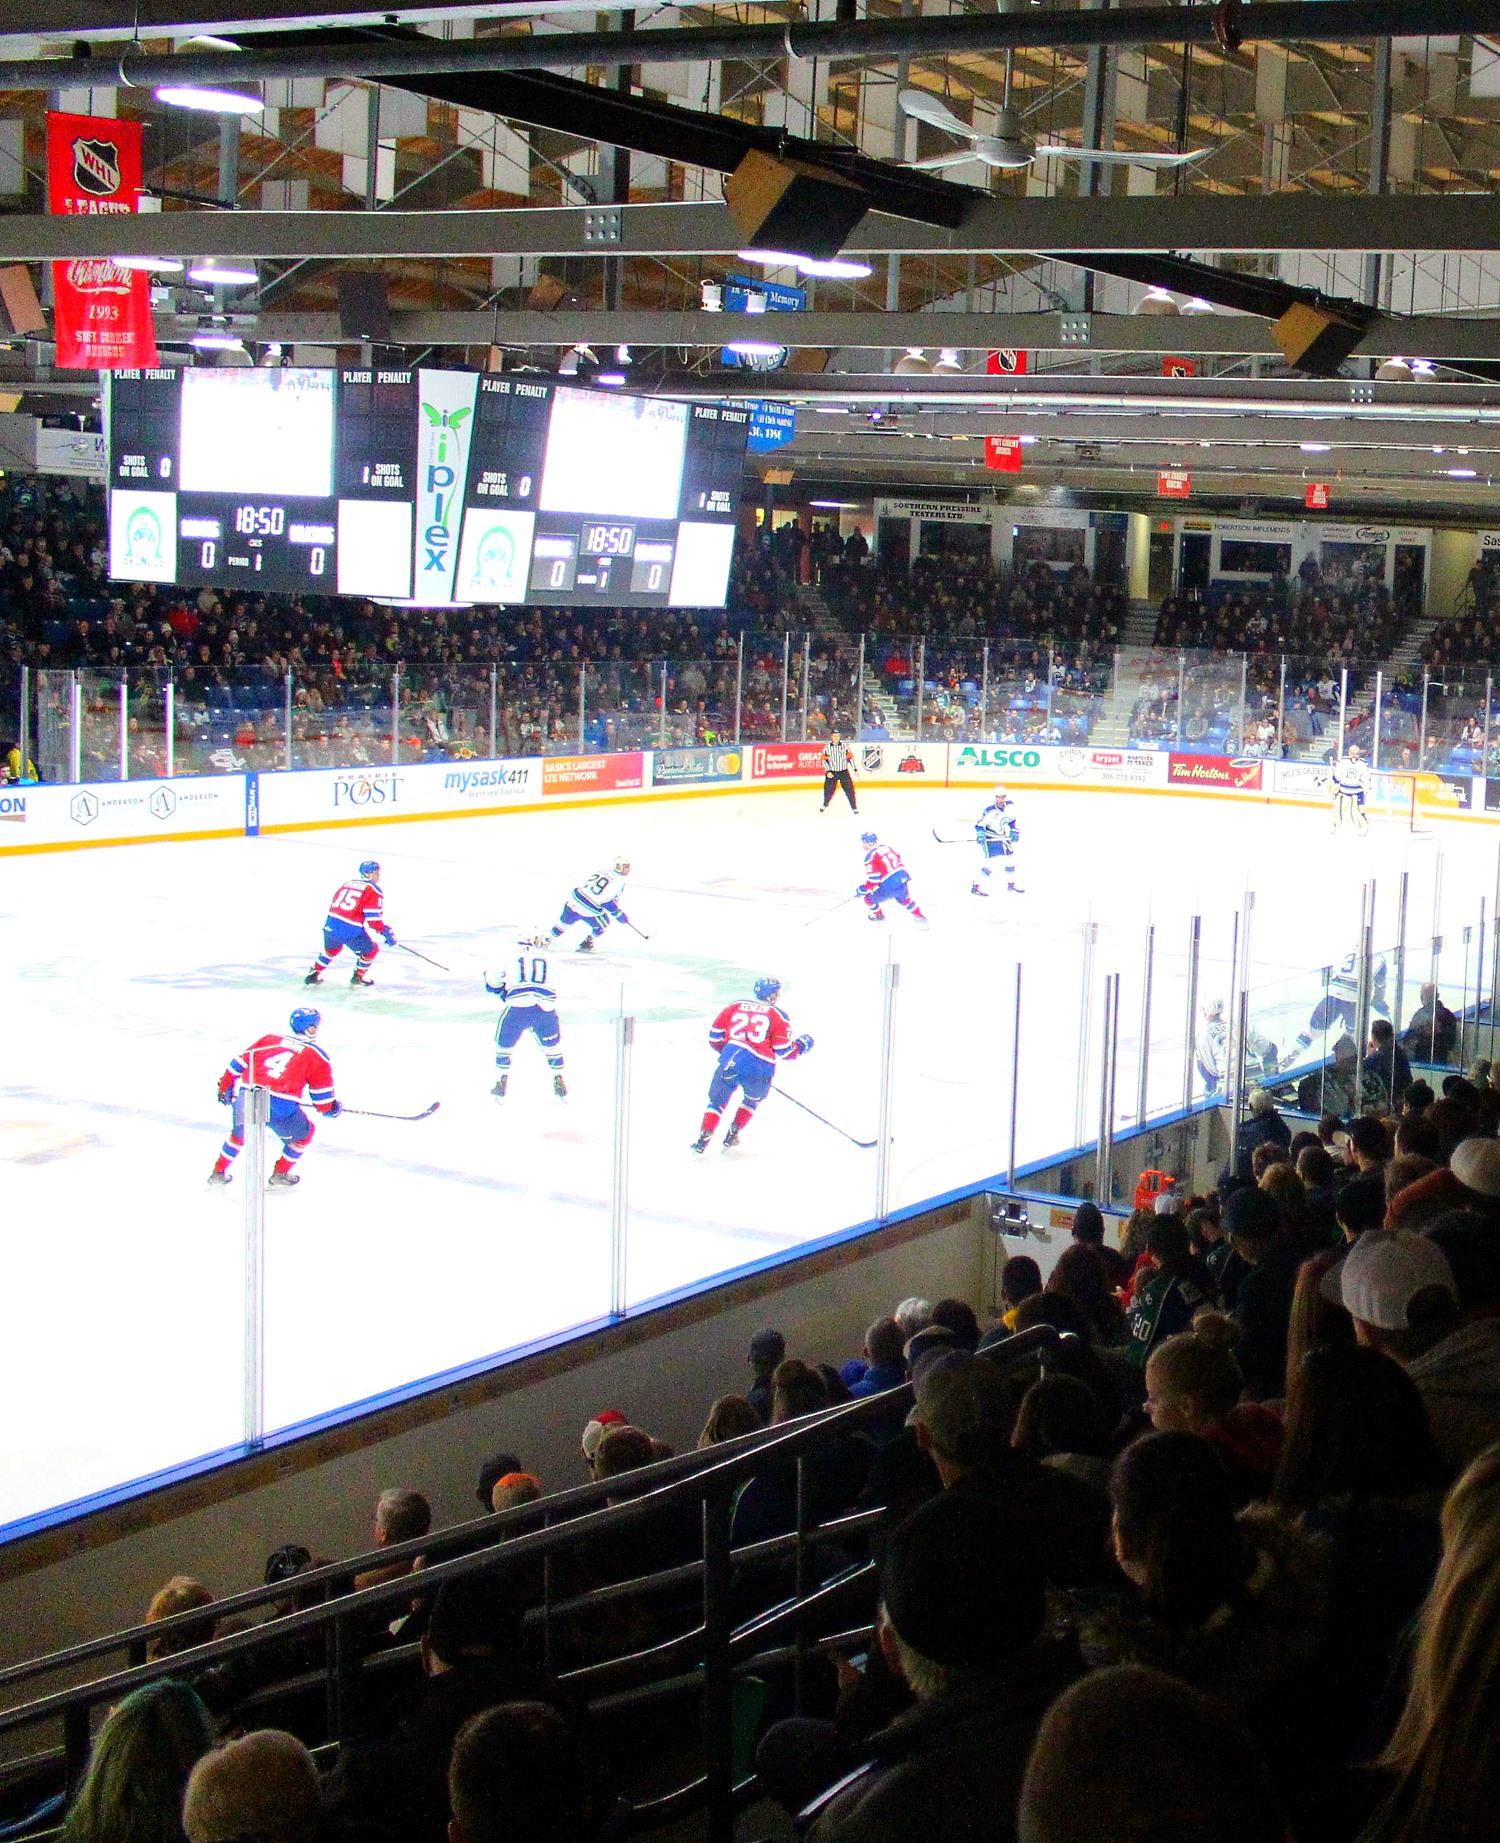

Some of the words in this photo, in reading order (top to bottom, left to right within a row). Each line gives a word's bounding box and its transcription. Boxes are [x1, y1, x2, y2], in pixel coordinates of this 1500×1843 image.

[89, 304, 120, 320] 1993
[114, 369, 141, 380] PLAYER
[145, 369, 176, 380] PENALTY
[343, 371, 372, 384] PLAYER
[377, 372, 411, 384] PENALTY
[482, 379, 511, 394] PLAYER
[515, 383, 548, 398] PENALTY
[694, 406, 718, 421] PLAYER
[721, 409, 748, 424] PENALTY
[123, 454, 146, 466] SHOTS
[119, 466, 130, 478] ON
[131, 466, 149, 478] GOAL
[375, 463, 400, 475] SHOTS
[371, 475, 384, 487] ON
[384, 475, 404, 488] GOAL
[482, 471, 507, 484] SHOTS
[477, 483, 490, 495] ON
[490, 484, 509, 497] GOAL
[710, 490, 730, 502] SHOTS
[706, 500, 717, 512] ON
[717, 501, 731, 513] GOAL
[893, 502, 938, 511] SOUTHERN
[940, 505, 981, 513] PRESSURE
[235, 506, 285, 535] 18:50
[910, 510, 945, 519] TESTERS
[587, 526, 633, 554] 18:50
[201, 541, 216, 569] 0
[228, 556, 249, 567] PERIOD
[310, 547, 325, 575] 0
[550, 560, 566, 588] 0
[648, 564, 663, 590] 0
[767, 753, 788, 763] Bumper
[798, 752, 823, 761] GREAT
[955, 746, 1041, 768] ALSCO
[545, 762, 571, 773] SASK'S
[572, 759, 607, 771] LARGEST
[1172, 763, 1191, 776] Tim
[1191, 764, 1230, 780] Hortons
[338, 773, 398, 781] PRAIRIE
[444, 764, 529, 793] mysask411
[544, 773, 558, 783] LTE
[559, 771, 598, 782] NETWORK
[178, 793, 219, 801] ANDERSON
[333, 777, 405, 807] POST
[101, 798, 144, 806] ANDERSON
[584, 873, 610, 896] 29
[332, 887, 363, 911] 15
[518, 956, 548, 984] 10
[729, 1011, 771, 1044] 23
[264, 1050, 295, 1079] 4
